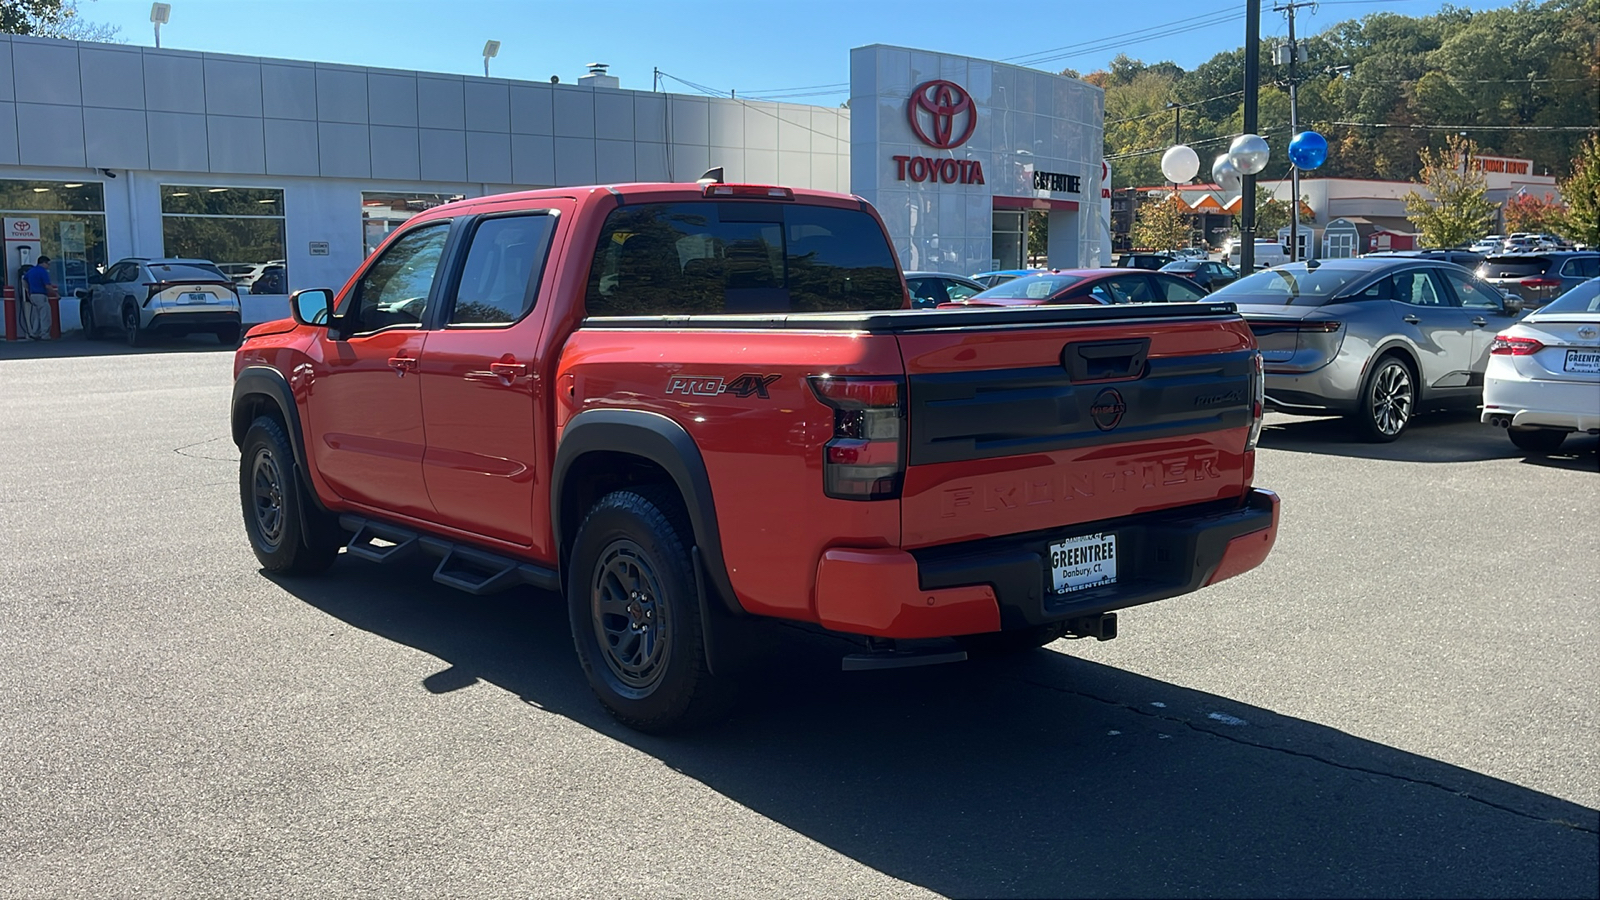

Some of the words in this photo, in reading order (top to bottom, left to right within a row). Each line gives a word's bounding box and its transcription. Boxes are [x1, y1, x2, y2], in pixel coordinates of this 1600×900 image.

[893, 155, 985, 185] TOYOTA
[1483, 159, 1504, 173] HOME
[1506, 160, 1528, 174] DEPOT
[1034, 171, 1081, 193] GREENTREE
[1091, 404, 1125, 414] NISSAN
[941, 451, 1221, 518] FRONTIER
[1052, 542, 1113, 569] GREENTREE
[1063, 567, 1093, 578] Danbury,
[1093, 563, 1103, 573] CT.
[1057, 577, 1117, 595] GREENTREE
